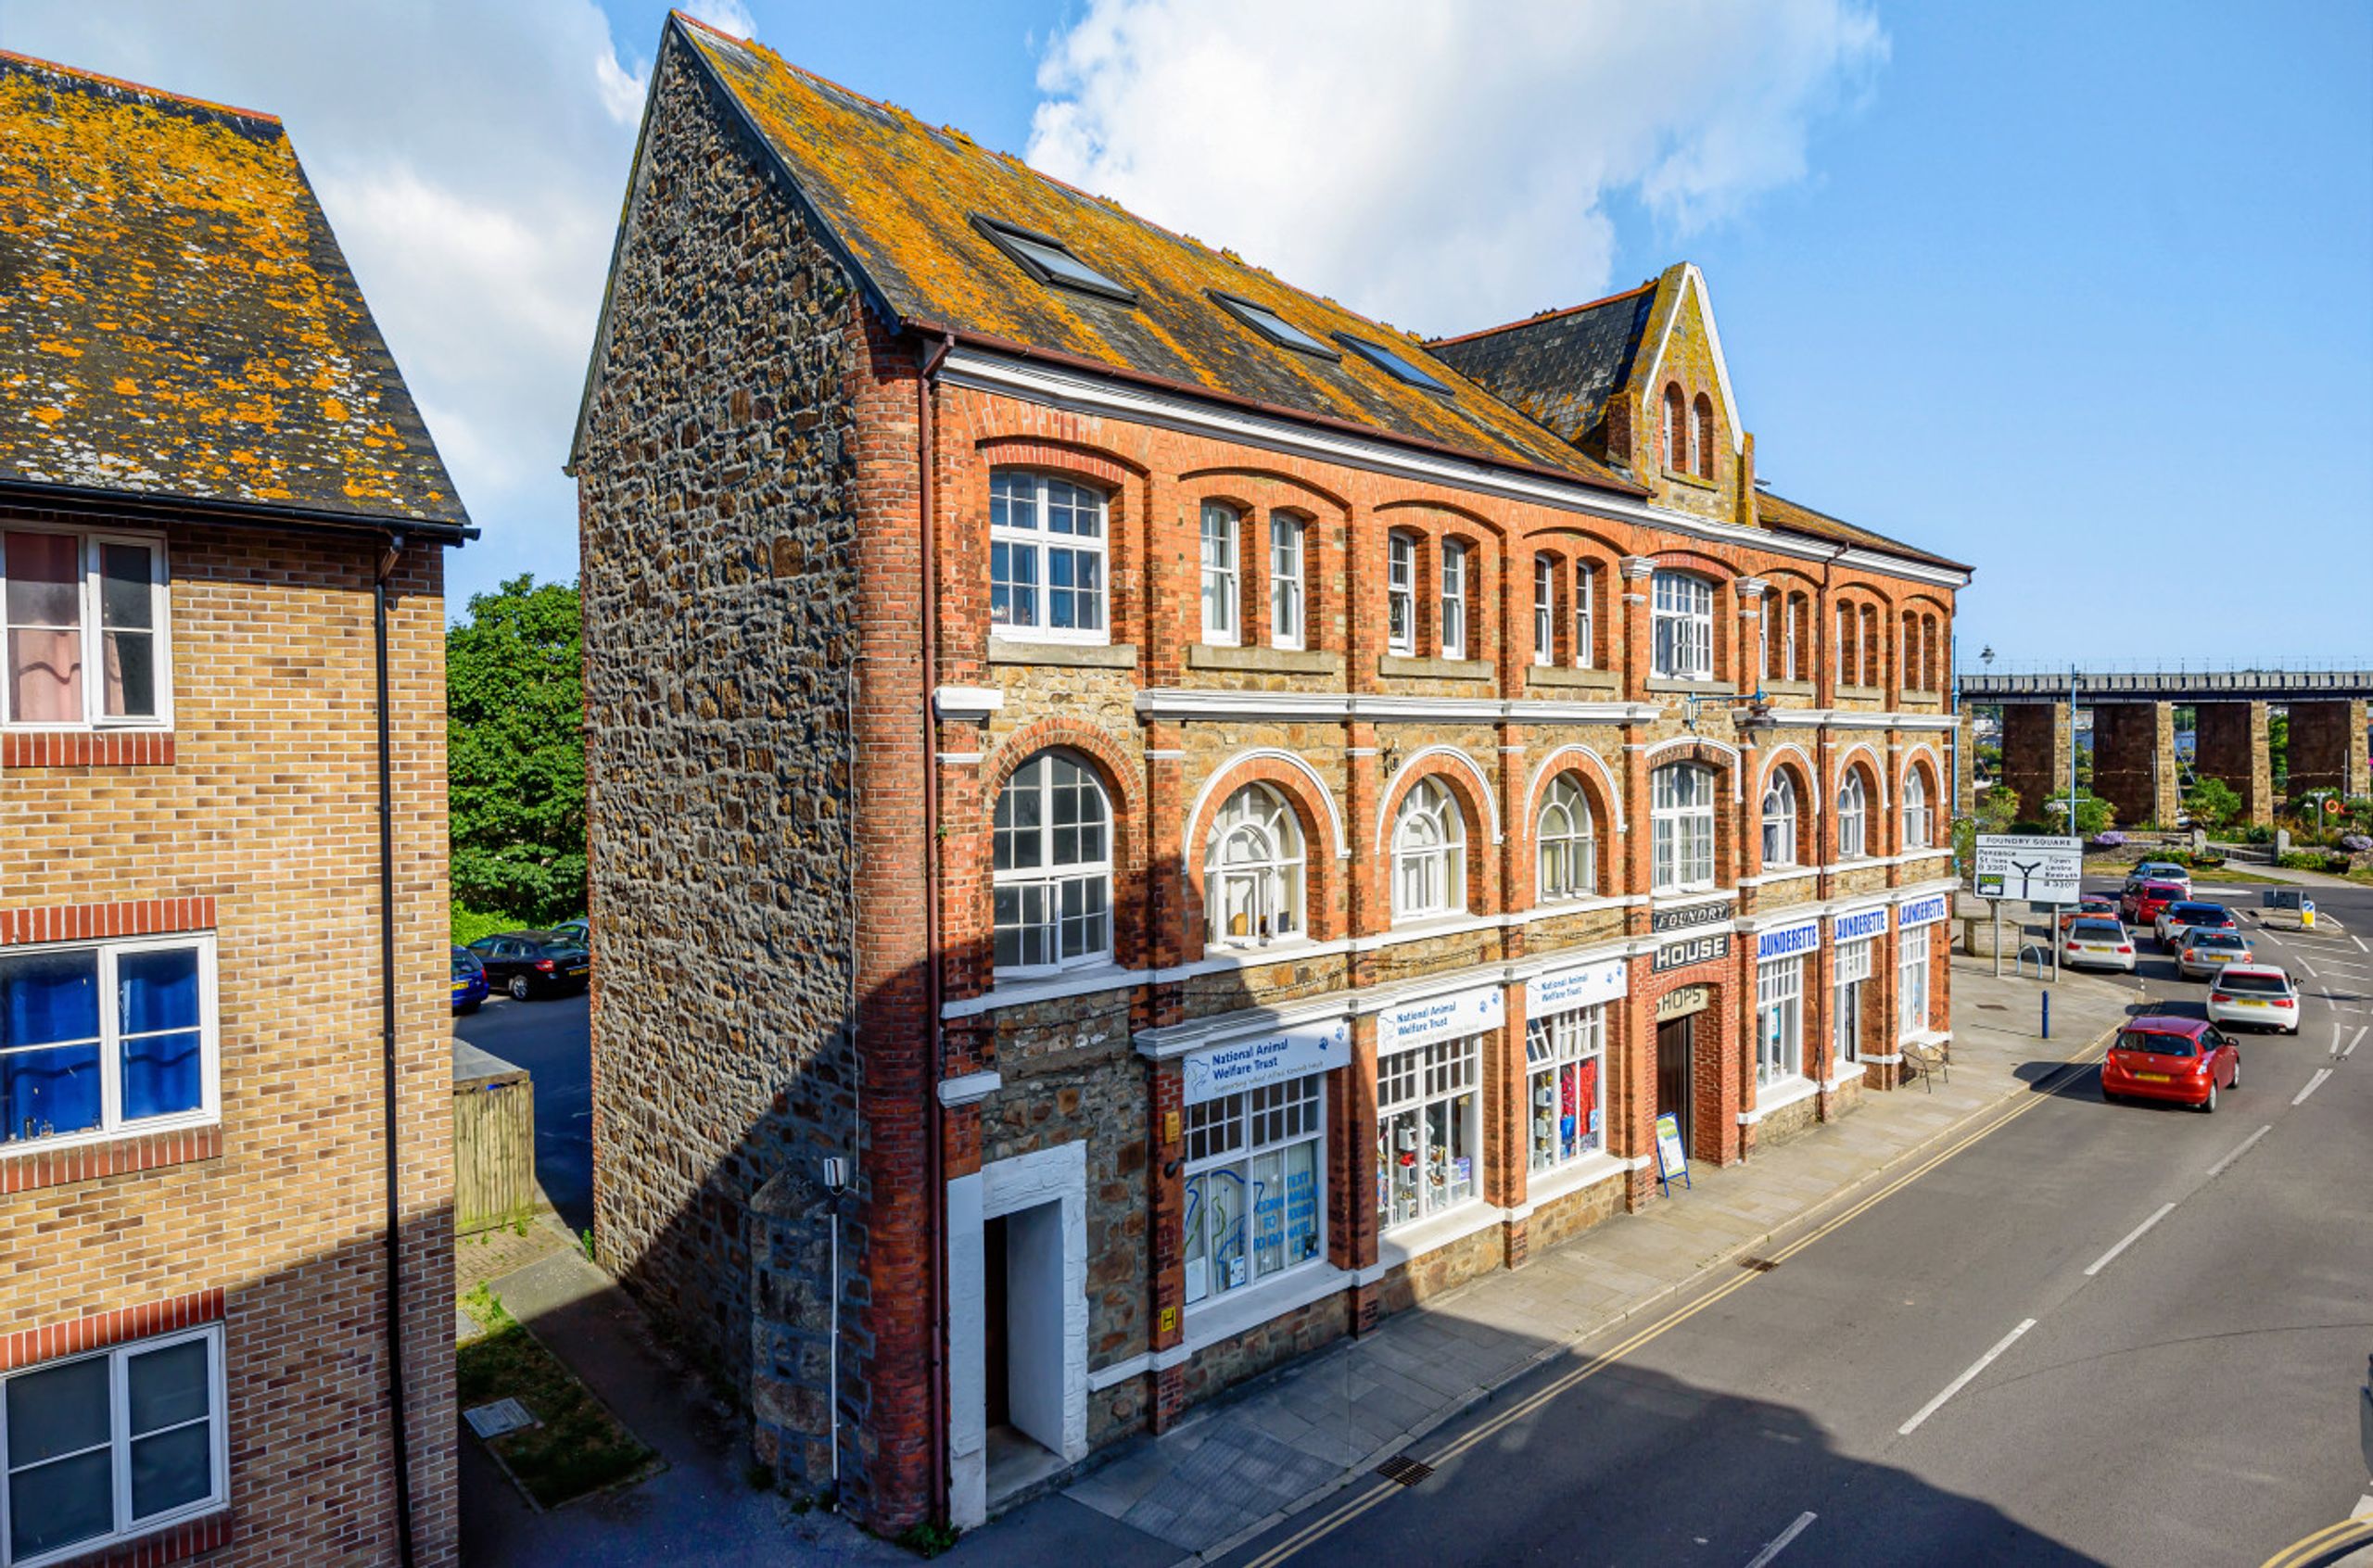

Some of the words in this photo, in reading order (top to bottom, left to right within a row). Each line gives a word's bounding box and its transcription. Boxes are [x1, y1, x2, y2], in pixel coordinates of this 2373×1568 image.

[1986, 837, 2030, 845] FOUNDRY
[1657, 904, 1726, 928] FOUNDRY
[1834, 910, 1885, 940] AUNDERETTE
[1656, 937, 1725, 969] HOUSE
[1757, 925, 1817, 959] AUNDERETTE
[1542, 977, 1567, 990] National
[1568, 972, 1589, 985] Animal
[1542, 990, 1566, 1002] Welfare
[1567, 987, 1583, 996] Trust
[1397, 1007, 1429, 1023] National
[1430, 1001, 1456, 1016] Animal
[1397, 1022, 1428, 1036] Welfare
[1429, 1018, 1448, 1029] Trust
[1212, 1046, 1252, 1066] National
[1256, 1038, 1288, 1056] Animal
[1212, 1064, 1251, 1081] Welfare
[1254, 1056, 1277, 1071] Trust
